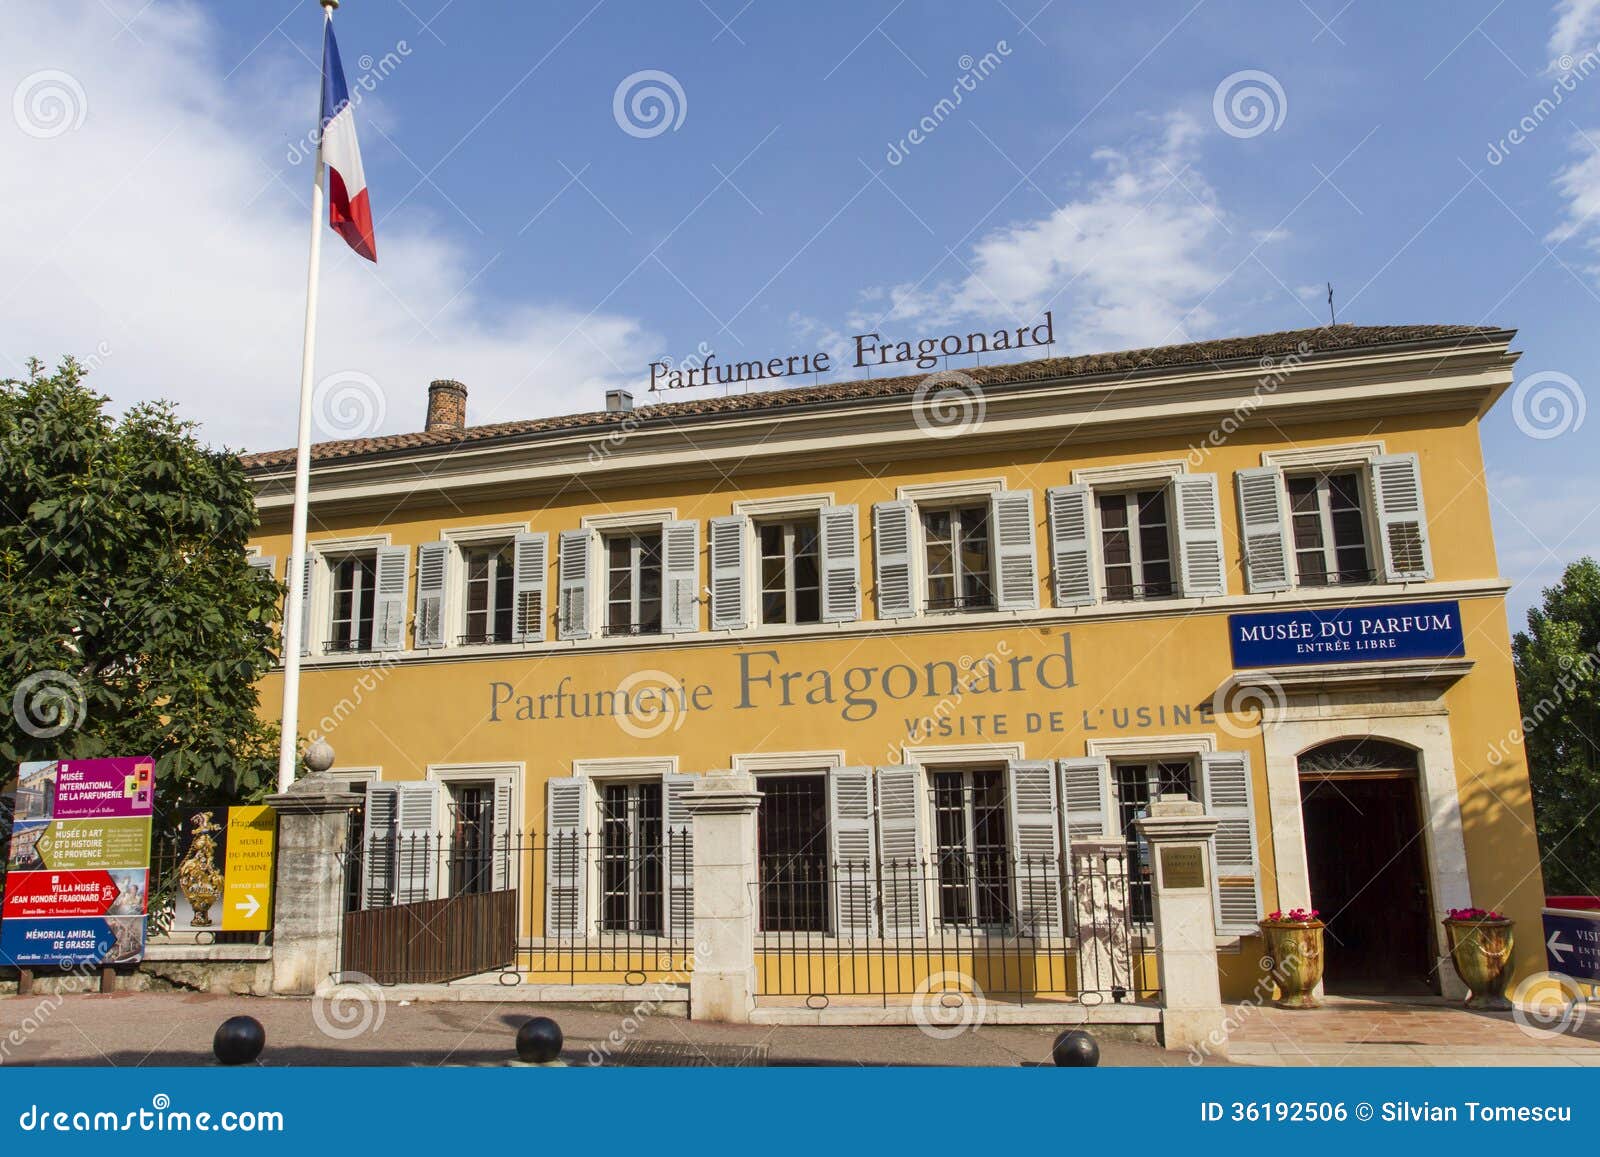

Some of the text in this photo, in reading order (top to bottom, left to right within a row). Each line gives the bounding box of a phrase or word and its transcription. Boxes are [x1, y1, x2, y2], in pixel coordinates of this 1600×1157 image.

[648, 312, 1056, 392] Parfumerie Fragonard
[1241, 614, 1452, 642] MUSÉE DU PARFUM
[1296, 638, 1397, 653] ENTRÉE LIBRE
[488, 632, 1080, 722] Parfumerie Fragonard
[904, 703, 1216, 739] VISITE DE L'USINE
[60, 771, 84, 781] MUSÉE
[59, 781, 113, 791] INTERNATIONAL
[59, 793, 68, 801] DE
[79, 790, 123, 800] PARFUMERIE
[55, 828, 80, 839] MUSÉE
[53, 849, 102, 859] DE PROVENCE
[51, 881, 100, 893] VILLA MUSÉE
[10, 893, 100, 904] JEAN HONORÉ FRAGONARD
[26, 929, 96, 940] MÉMORIAL AMIRAL
[53, 940, 95, 949] DE GRASSE
